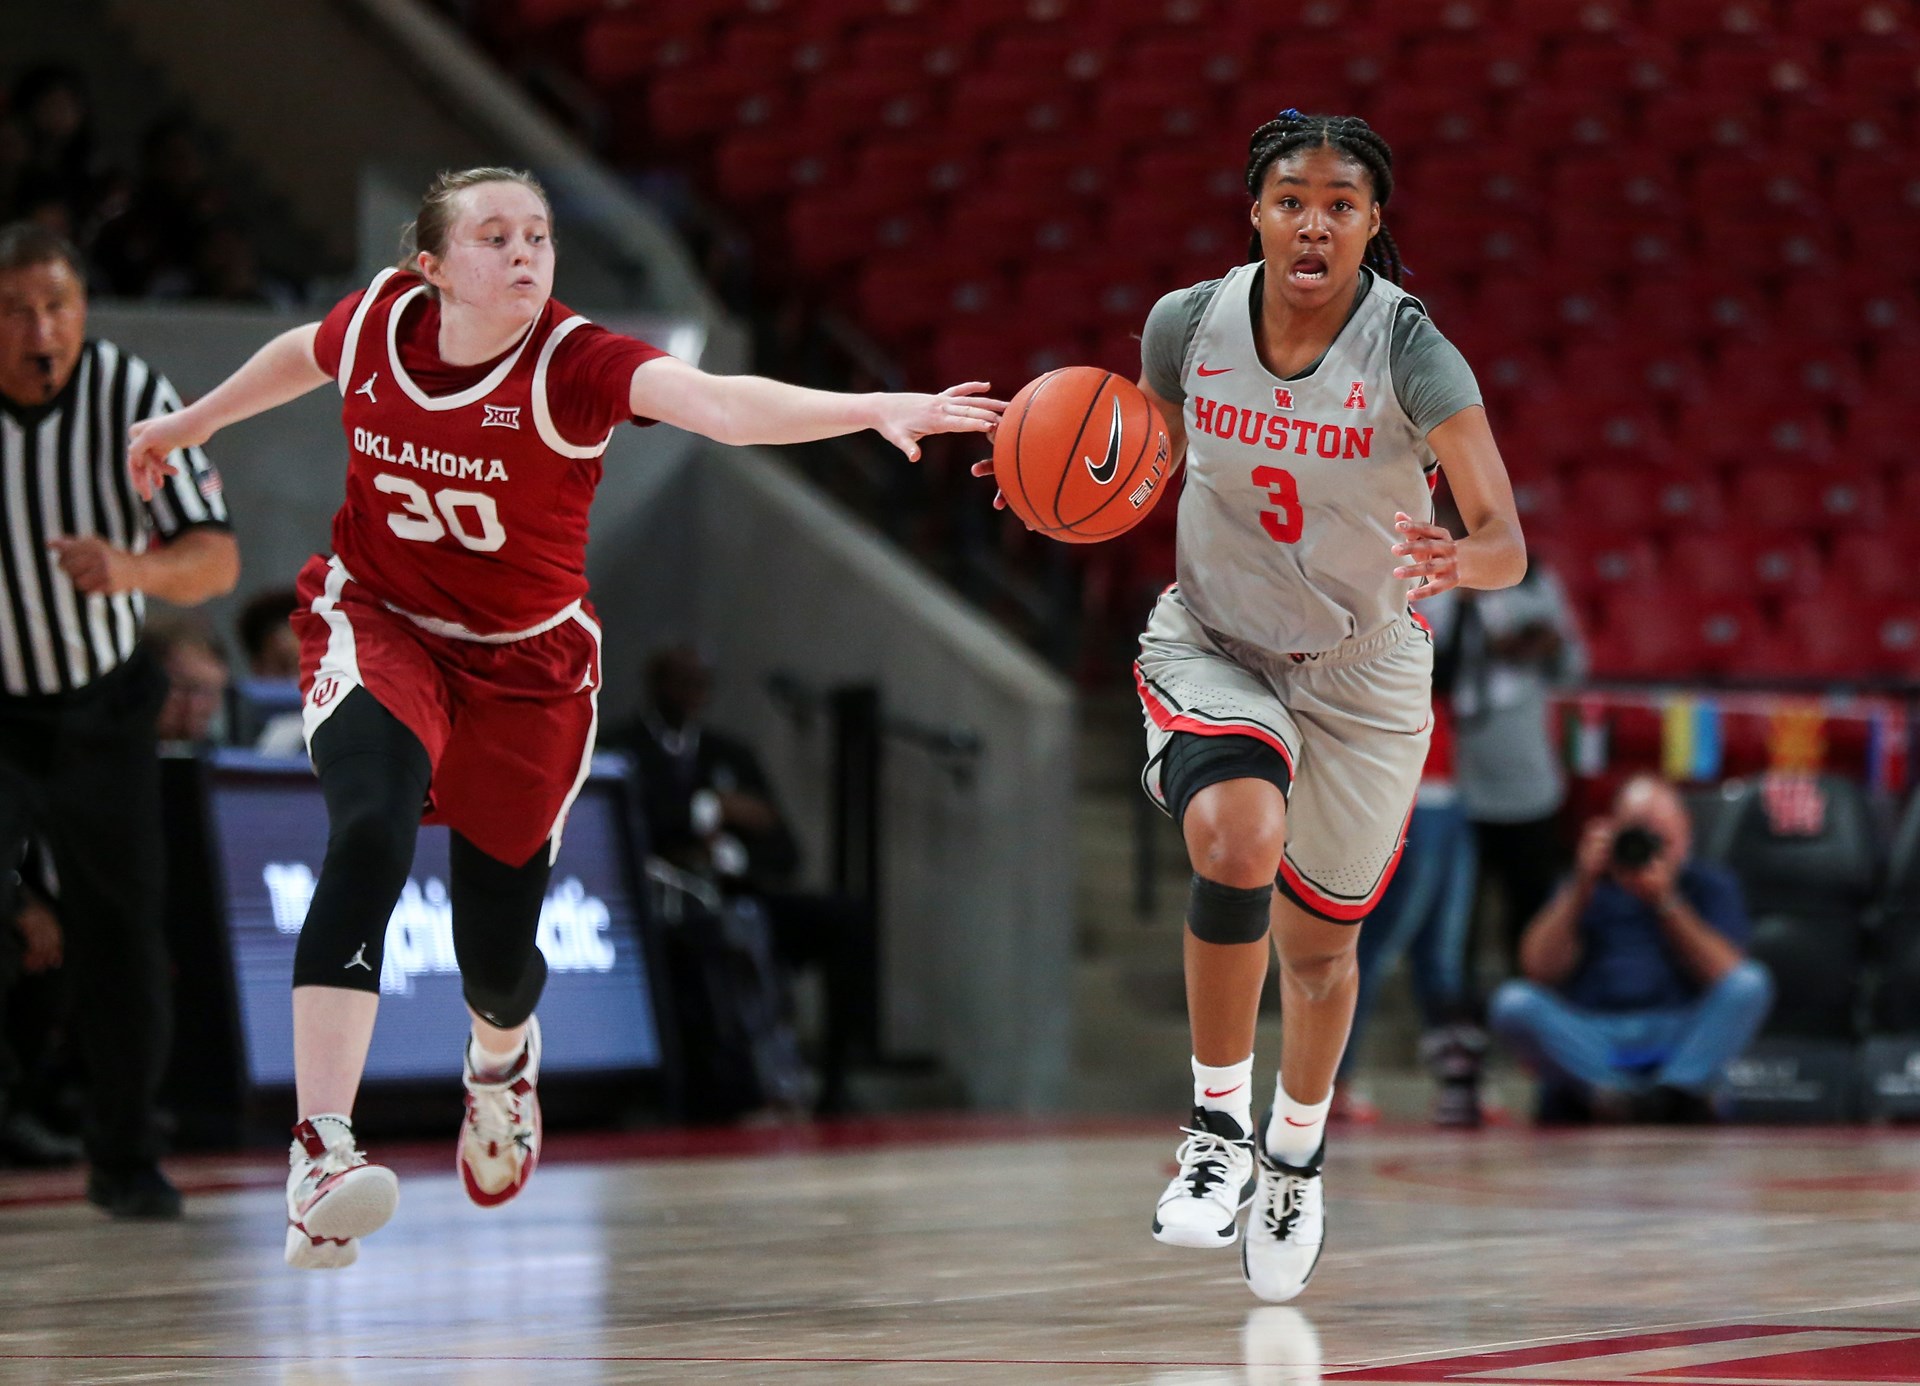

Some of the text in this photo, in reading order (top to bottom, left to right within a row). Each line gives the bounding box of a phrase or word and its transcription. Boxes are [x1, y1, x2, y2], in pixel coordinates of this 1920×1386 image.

[482, 403, 521, 430] XII
[1195, 396, 1374, 460] HOUSTON
[354, 426, 509, 483] OKLAHOMA
[1128, 431, 1169, 509] ELITE
[373, 472, 507, 553] 30
[1251, 464, 1304, 545] 3
